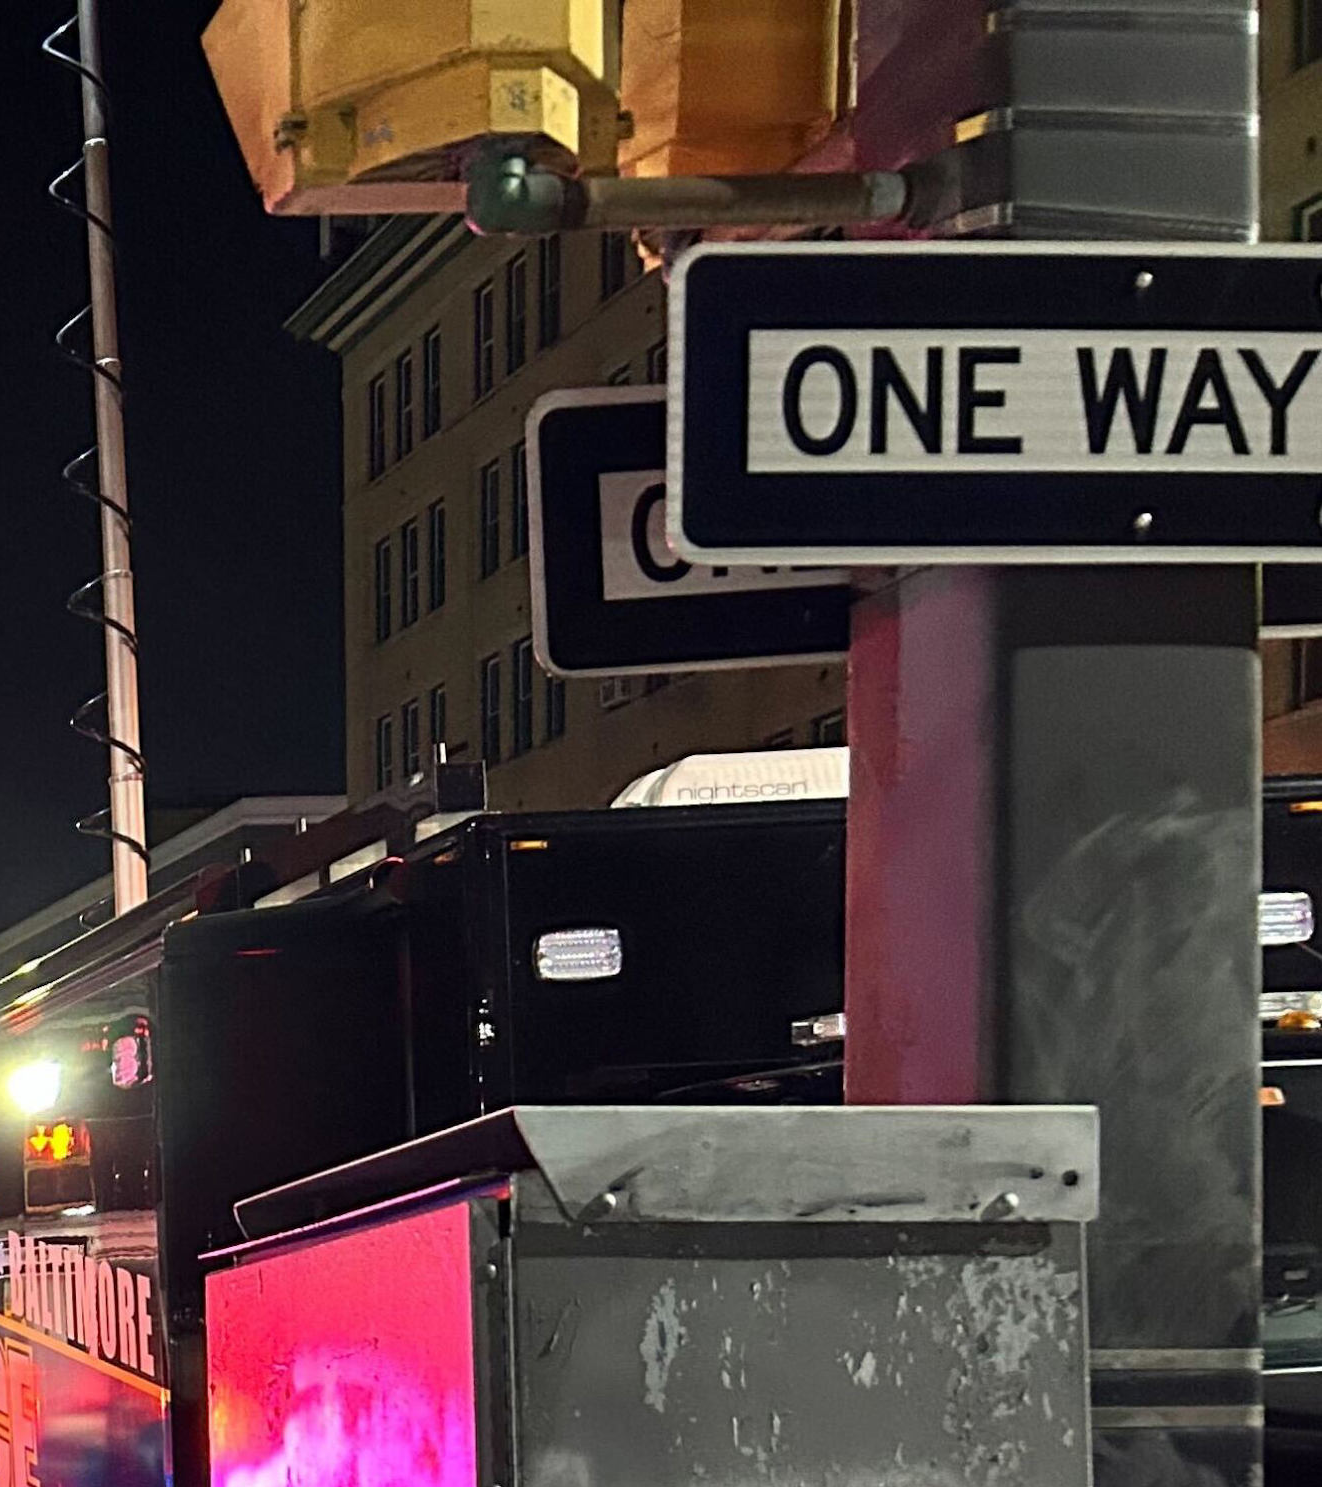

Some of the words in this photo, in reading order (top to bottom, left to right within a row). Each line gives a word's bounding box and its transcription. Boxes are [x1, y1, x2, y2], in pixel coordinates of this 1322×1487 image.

[782, 345, 1024, 457] ONE
[1078, 346, 1321, 456] WAY
[678, 779, 808, 803] nightscan
[7, 1230, 155, 1377] BALTIMORE
